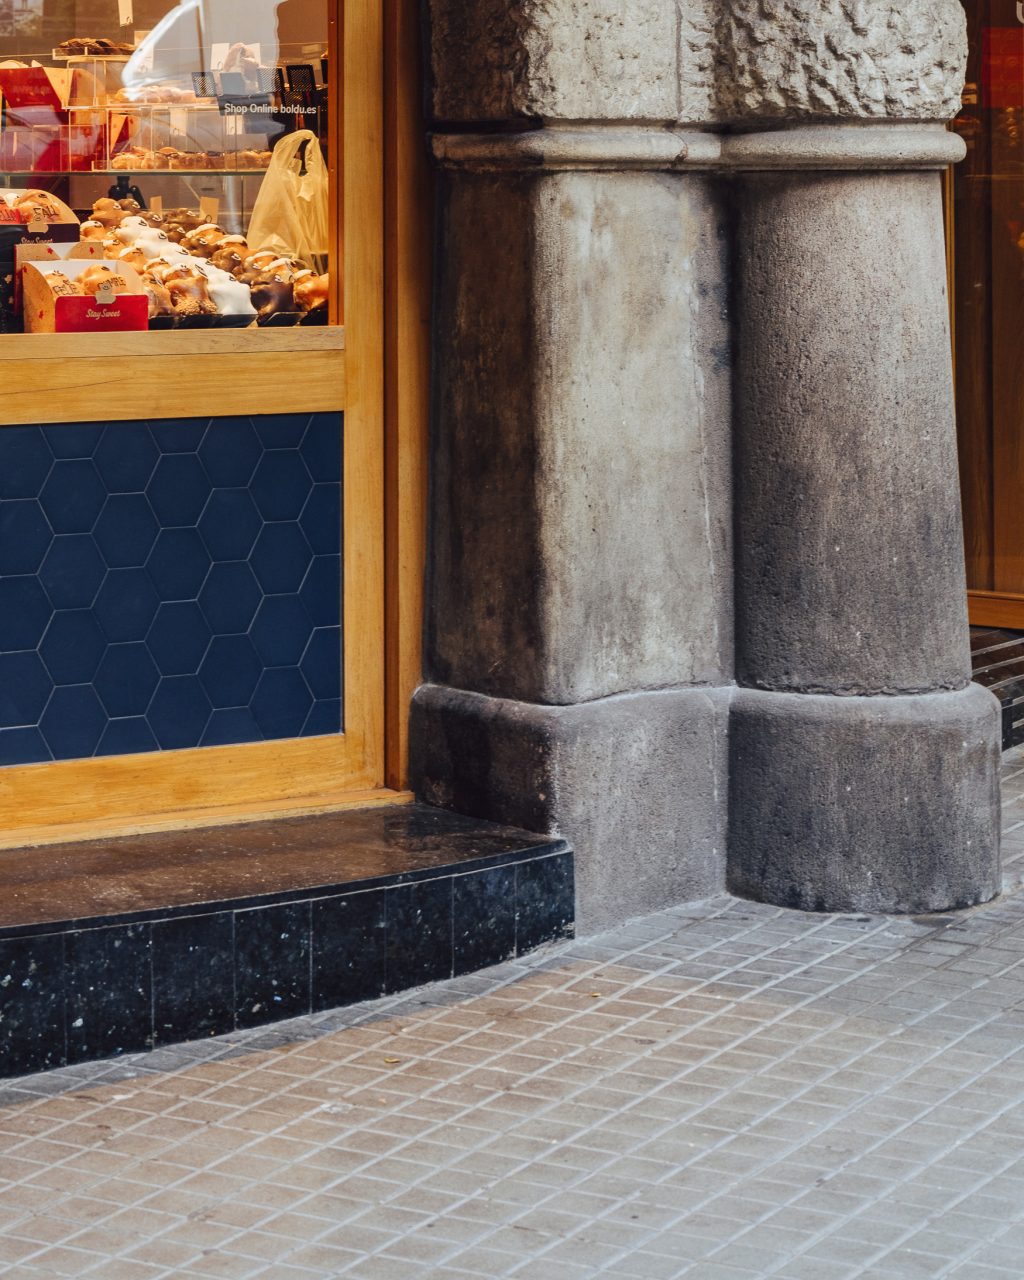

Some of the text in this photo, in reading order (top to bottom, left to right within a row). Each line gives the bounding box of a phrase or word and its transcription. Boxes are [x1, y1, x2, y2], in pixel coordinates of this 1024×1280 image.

[224, 103, 317, 114] Shop Online boldu.es
[86, 308, 121, 320] Stay Sweet
